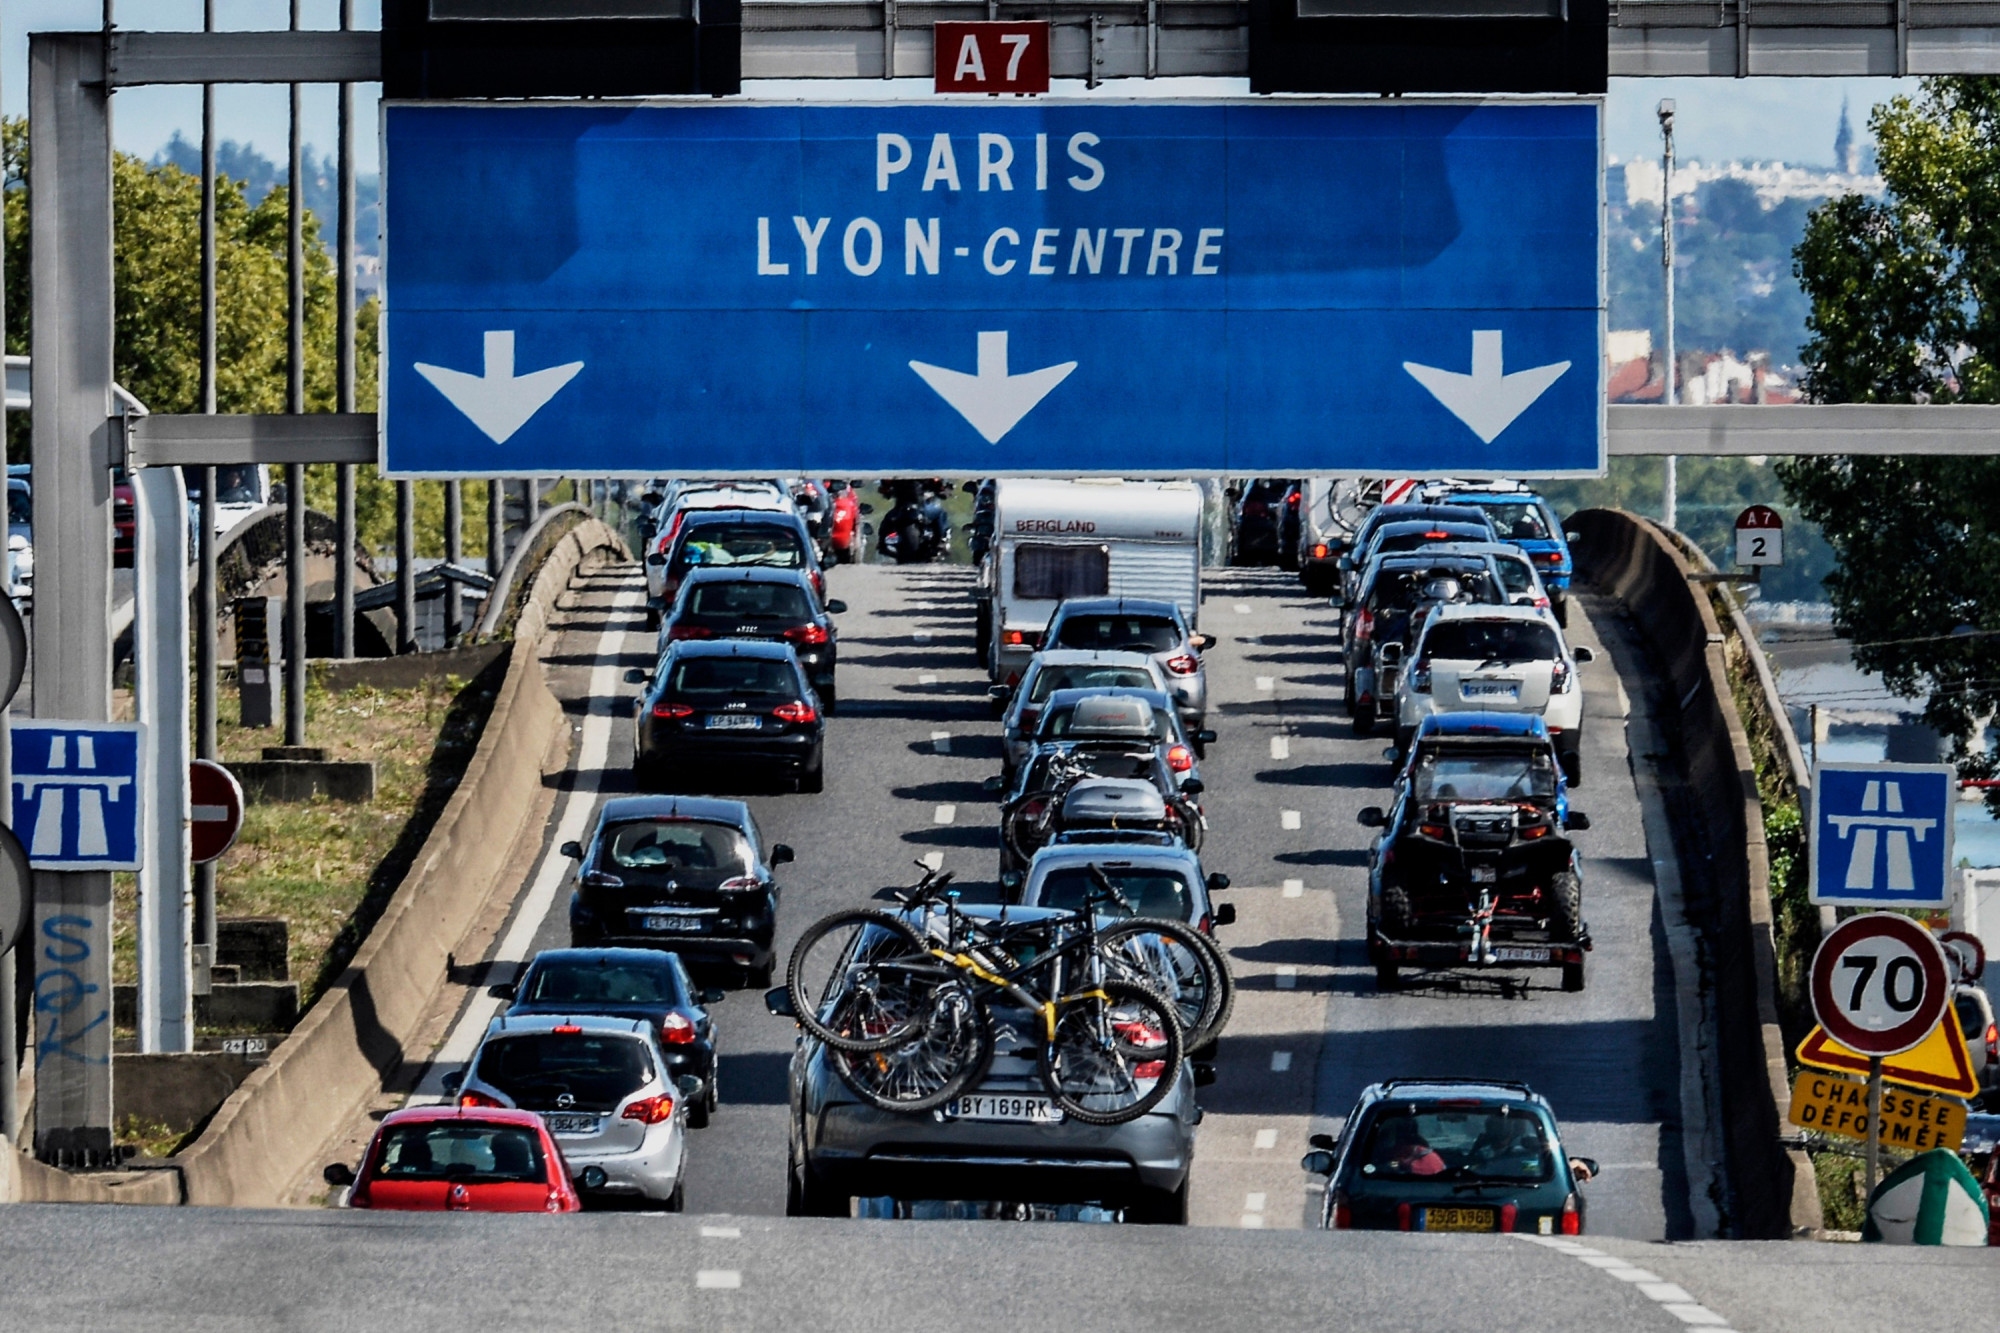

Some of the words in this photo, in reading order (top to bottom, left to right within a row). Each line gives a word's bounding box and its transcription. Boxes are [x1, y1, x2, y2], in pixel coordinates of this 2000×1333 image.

[876, 132, 1105, 192] PARIS
[756, 216, 1224, 277] LYON-CENTRE
[1016, 520, 1096, 533] BERGLAND
[1752, 537, 1767, 557] 2
[1842, 956, 1925, 1012] 70
[1812, 1080, 1951, 1126] CHASSÉE
